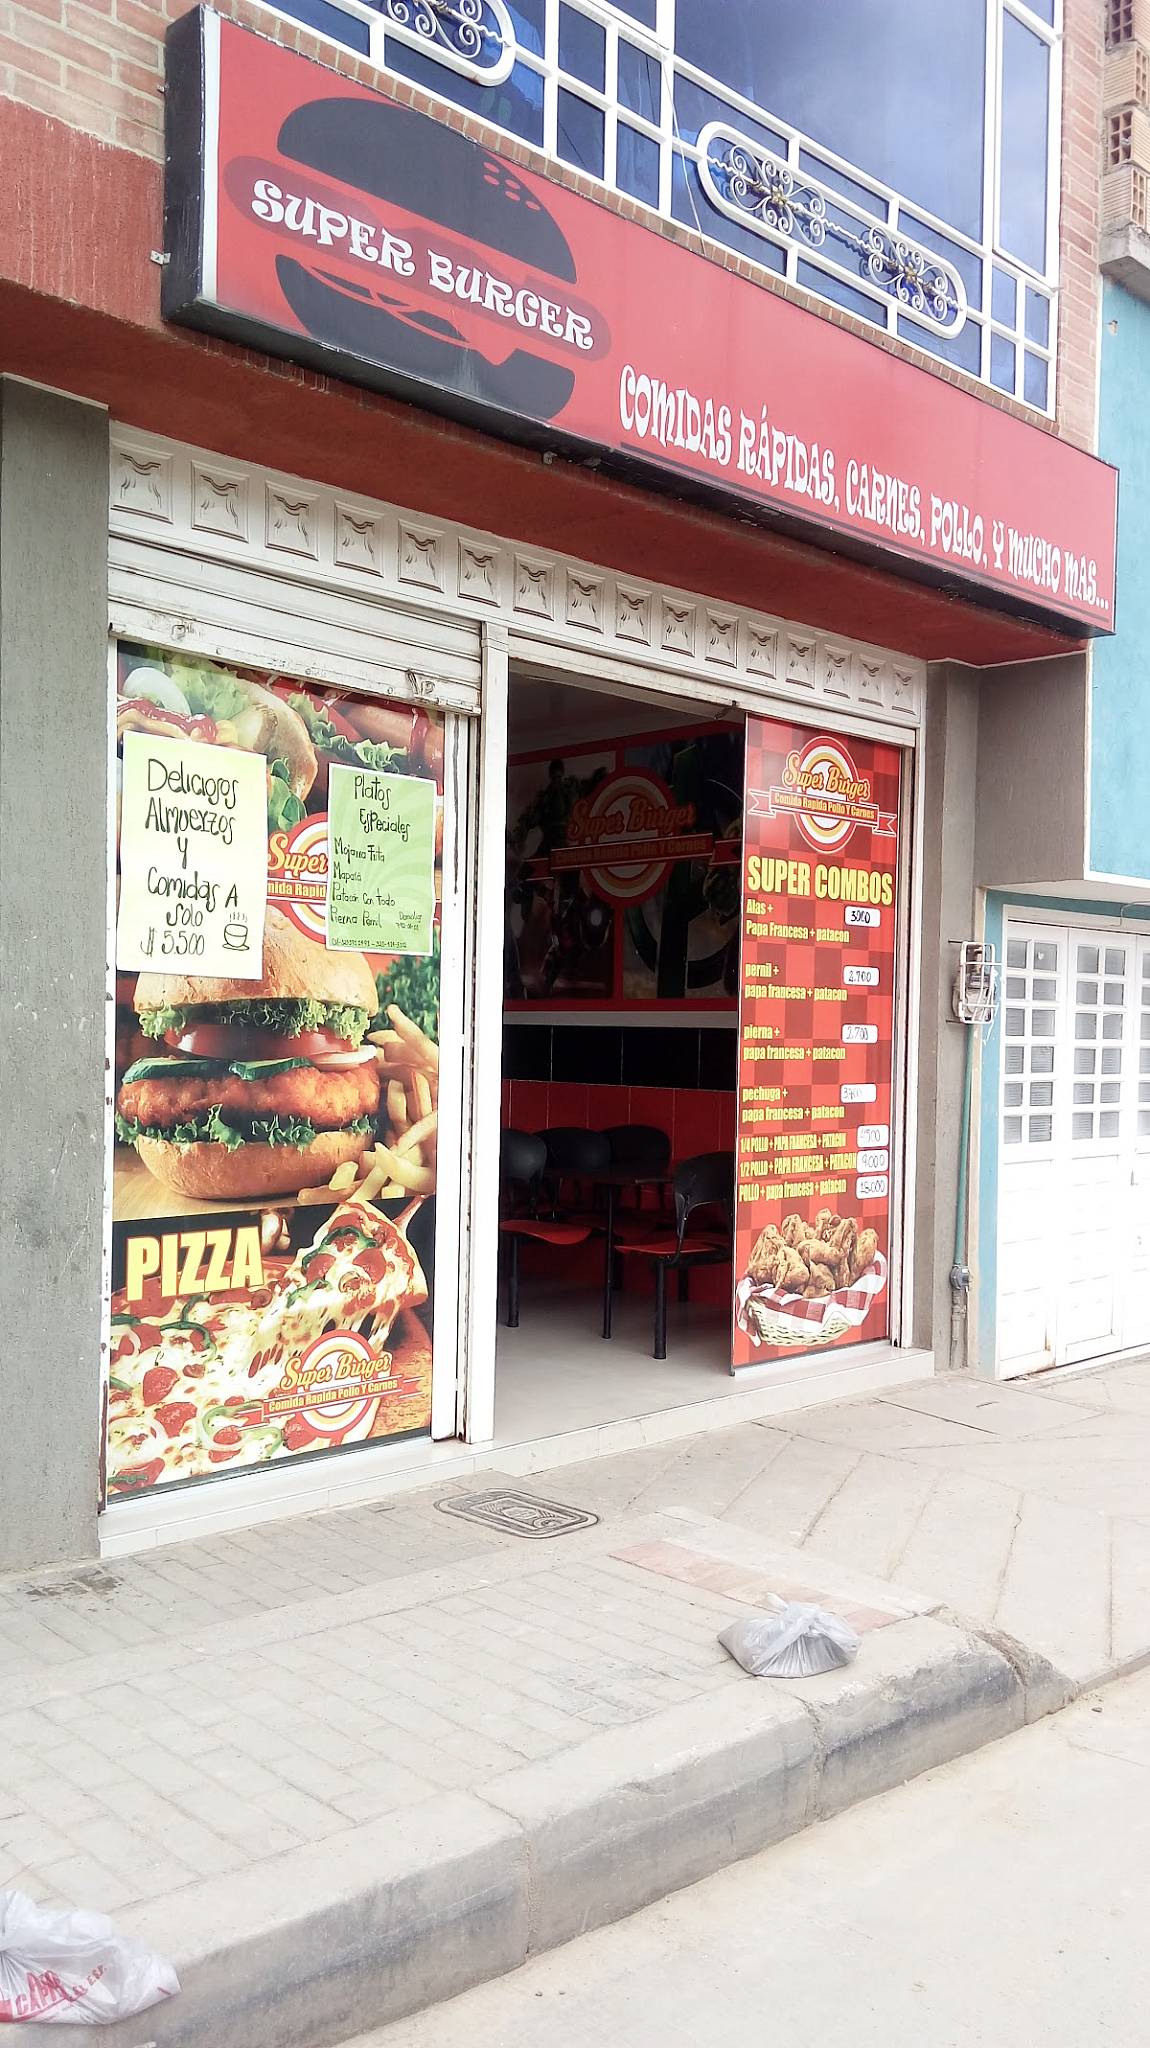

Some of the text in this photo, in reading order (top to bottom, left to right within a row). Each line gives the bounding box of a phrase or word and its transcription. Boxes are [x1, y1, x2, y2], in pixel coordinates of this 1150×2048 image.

[251, 179, 593, 350] SUPER BURGER
[620, 364, 732, 466] COMIDAS
[737, 404, 839, 513] RÁPIDAS,
[846, 459, 925, 546] CARNES,
[930, 494, 988, 569] POLLO,
[992, 520, 1004, 569] Y
[1007, 528, 1060, 593] MUCHO
[148, 758, 239, 809] Deliciosos
[783, 751, 871, 799] Super Burger
[354, 776, 392, 810] Platos
[774, 792, 802, 807] Comida
[803, 797, 827, 811] Rapida
[828, 801, 845, 814] Pollo
[851, 805, 875, 819] Carnes
[145, 797, 236, 845] Almuerzos
[268, 833, 327, 878] Super
[148, 866, 239, 913] Comidas A
[747, 855, 893, 905] SUPER COMBOS
[746, 899, 767, 914] Alas
[746, 920, 769, 937] Papa
[769, 922, 809, 939] Francesa
[745, 963, 772, 978] pernil
[744, 984, 768, 999] papa
[768, 984, 806, 1000] francesa
[743, 1024, 773, 1040] pierna
[743, 1046, 766, 1061] papa
[767, 1045, 805, 1061] francesa
[742, 1086, 781, 1102] pechuga
[742, 1108, 764, 1123] papa
[766, 1106, 803, 1121] francesa
[751, 1137, 769, 1152] POLLO
[774, 1136, 788, 1151] PAPA
[788, 1134, 818, 1149] FRANCESA
[750, 1160, 768, 1177] POLLO
[774, 1158, 791, 1175] PAPA
[791, 1155, 824, 1173] FRANCESA
[739, 1183, 760, 1202] POLLO
[766, 1184, 784, 1201] papa
[783, 1180, 814, 1197] francesa
[127, 1226, 264, 1301] PIZZA
[281, 1352, 391, 1391] Super Burger
[269, 1379, 398, 1412] Comida Rapida Pollo Y Carnes
